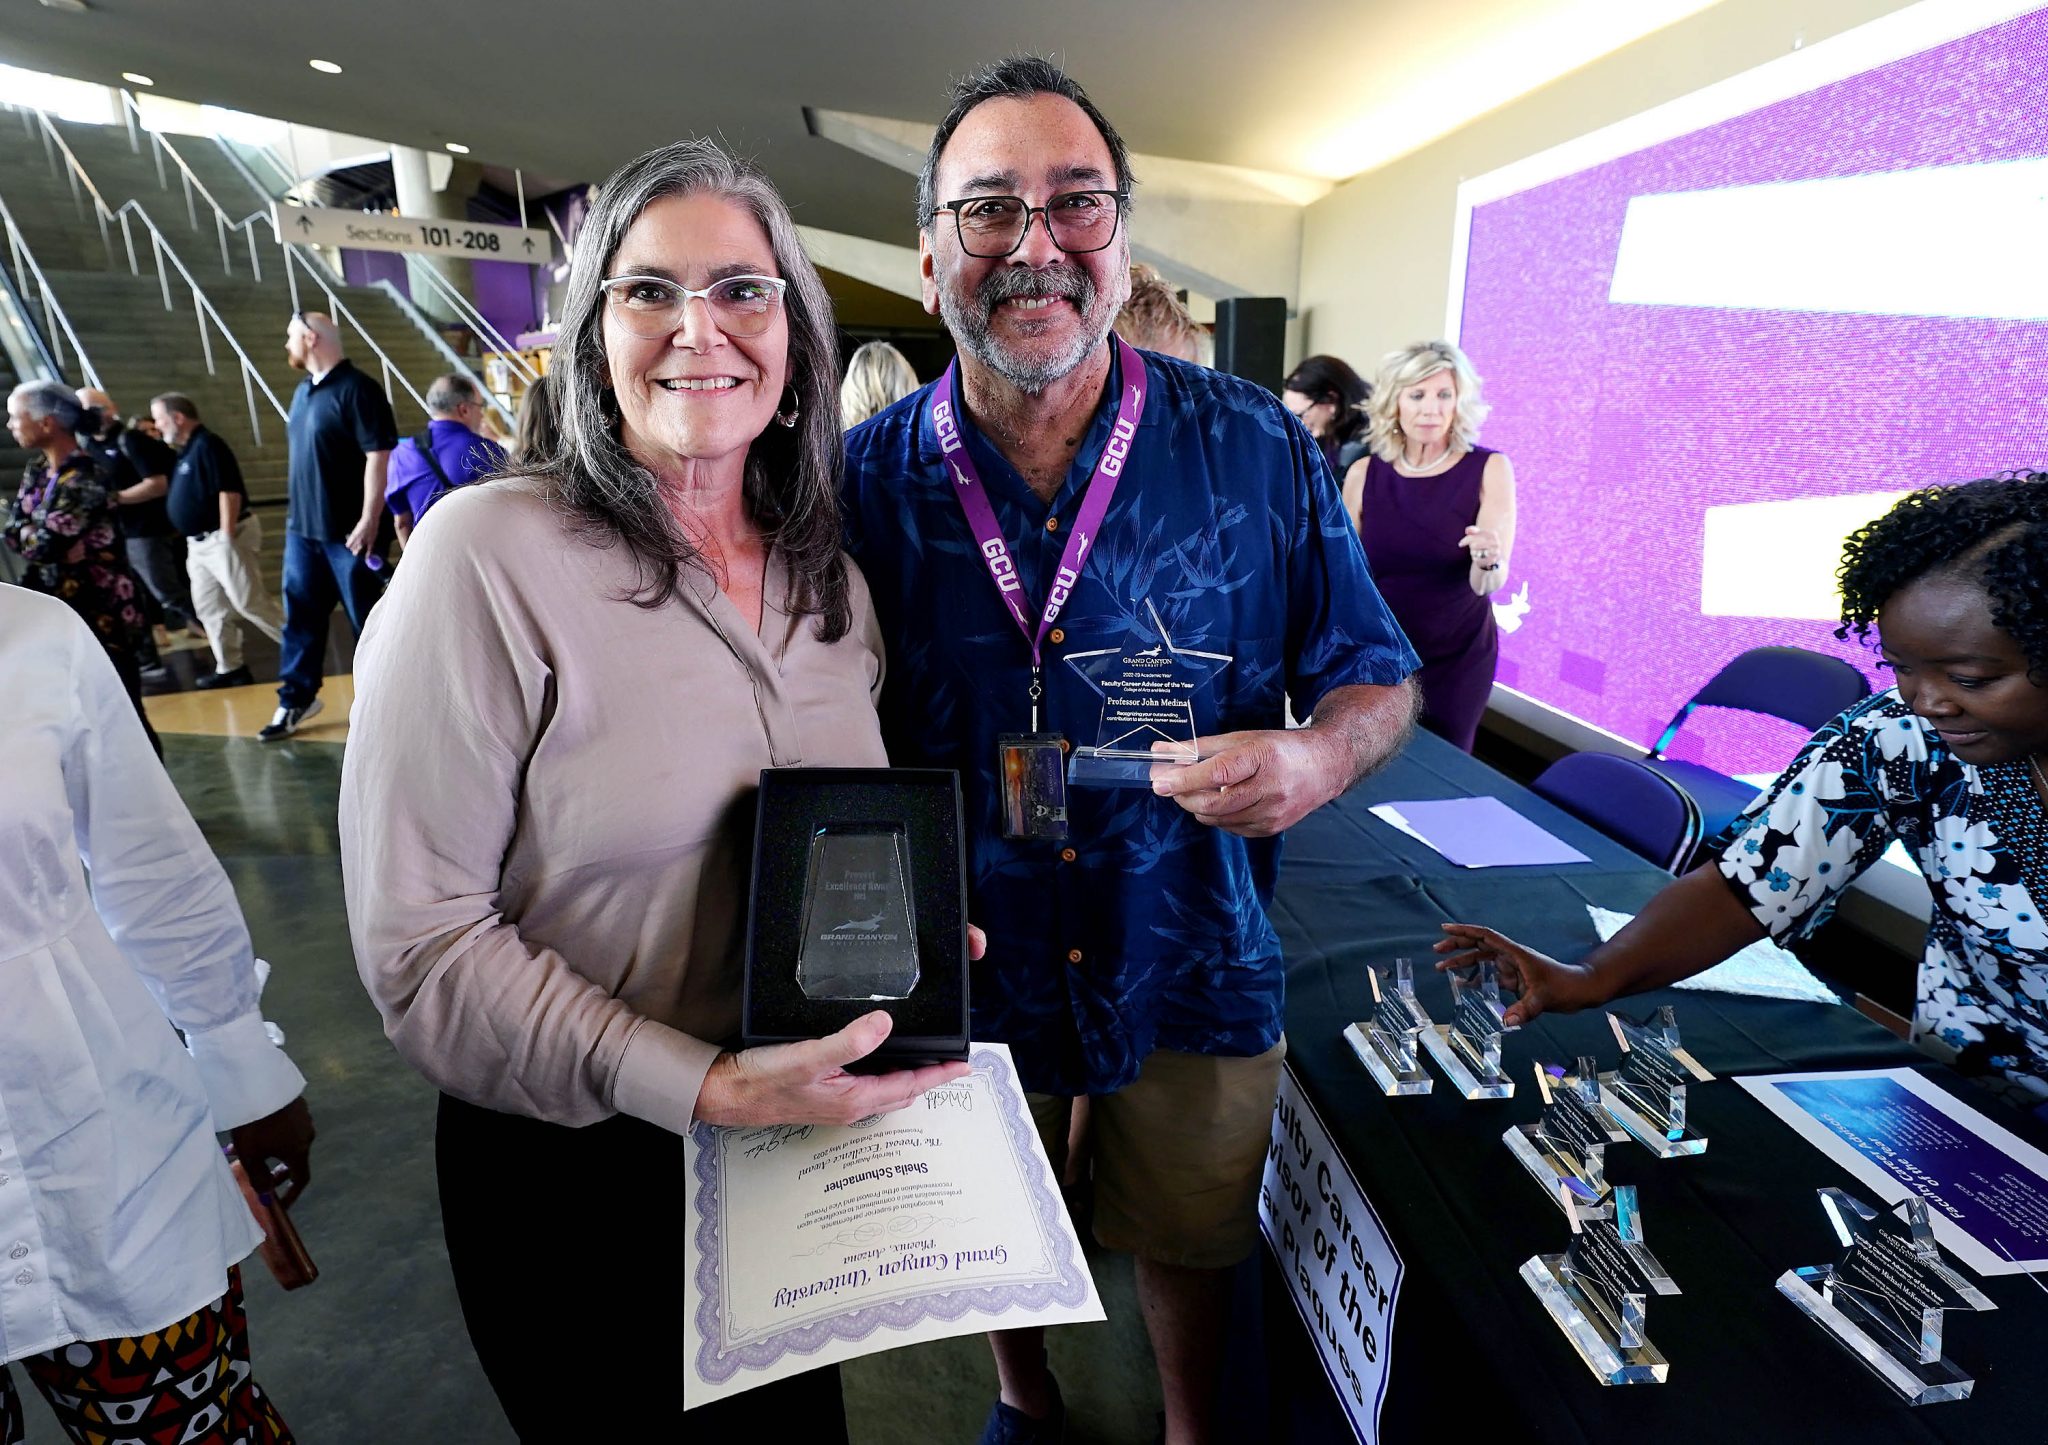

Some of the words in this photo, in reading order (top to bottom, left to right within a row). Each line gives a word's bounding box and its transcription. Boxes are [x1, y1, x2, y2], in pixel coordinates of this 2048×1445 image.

[345, 223, 412, 246] Sections
[420, 226, 500, 251] 101-208
[932, 400, 962, 454] GCU
[1100, 417, 1136, 477] GCU
[982, 537, 1021, 592] GCU
[1044, 566, 1077, 623] GCU
[1107, 697, 1140, 706] Professor
[1141, 698, 1159, 706] John
[1160, 698, 1188, 707] Medina
[833, 1143, 881, 1163] Excellence
[885, 1138, 921, 1148] Provost
[1868, 1137, 1896, 1156] Year
[894, 1162, 928, 1175] Sheila
[1868, 1150, 1913, 1181] Career
[1897, 1158, 1922, 1174] the
[824, 1167, 892, 1192] Schumacher
[1917, 1176, 1939, 1186] of
[855, 1197, 895, 1210] commitment
[856, 1191, 880, 1201] Provost
[1912, 1182, 1965, 1218] Faculty
[814, 1209, 846, 1223] excellence
[889, 1239, 936, 1256] Phoenix,
[1318, 1161, 1389, 1317] Career
[844, 1248, 885, 1264] Arizona
[879, 1250, 947, 1276] Canyon
[956, 1245, 1006, 1270] Grand
[1857, 1249, 1880, 1271] Professor
[1881, 1269, 1902, 1289] Michael
[774, 1269, 870, 1307] University
[1314, 1228, 1338, 1277] of
[1339, 1270, 1377, 1363] the
[1283, 1219, 1364, 1407] Plaques
